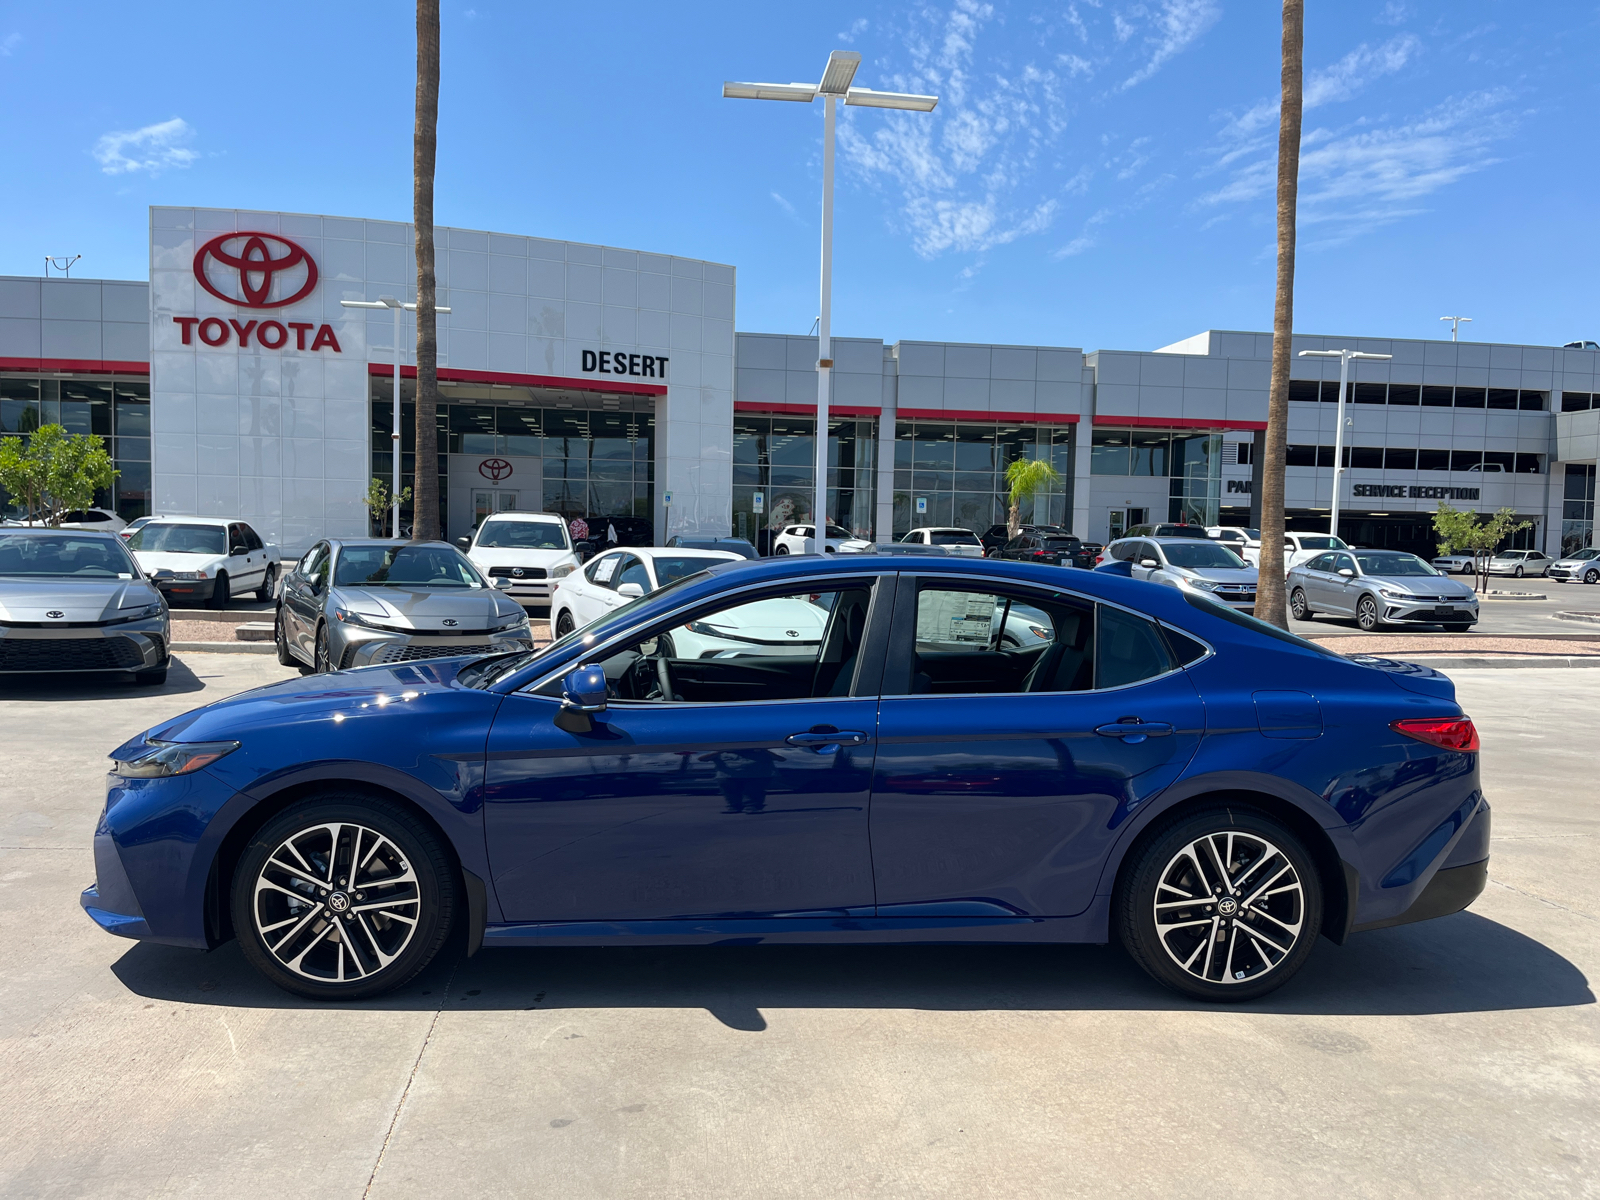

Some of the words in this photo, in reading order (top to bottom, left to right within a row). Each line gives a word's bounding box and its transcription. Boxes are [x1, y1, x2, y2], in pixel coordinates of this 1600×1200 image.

[173, 317, 341, 352] TOYOTA
[582, 350, 669, 378] DESERT
[1227, 480, 1252, 494] PAR
[1353, 484, 1407, 498] SERVICE
[1409, 486, 1480, 500] RECEPTION
[1141, 833, 1180, 893] TURANZA
